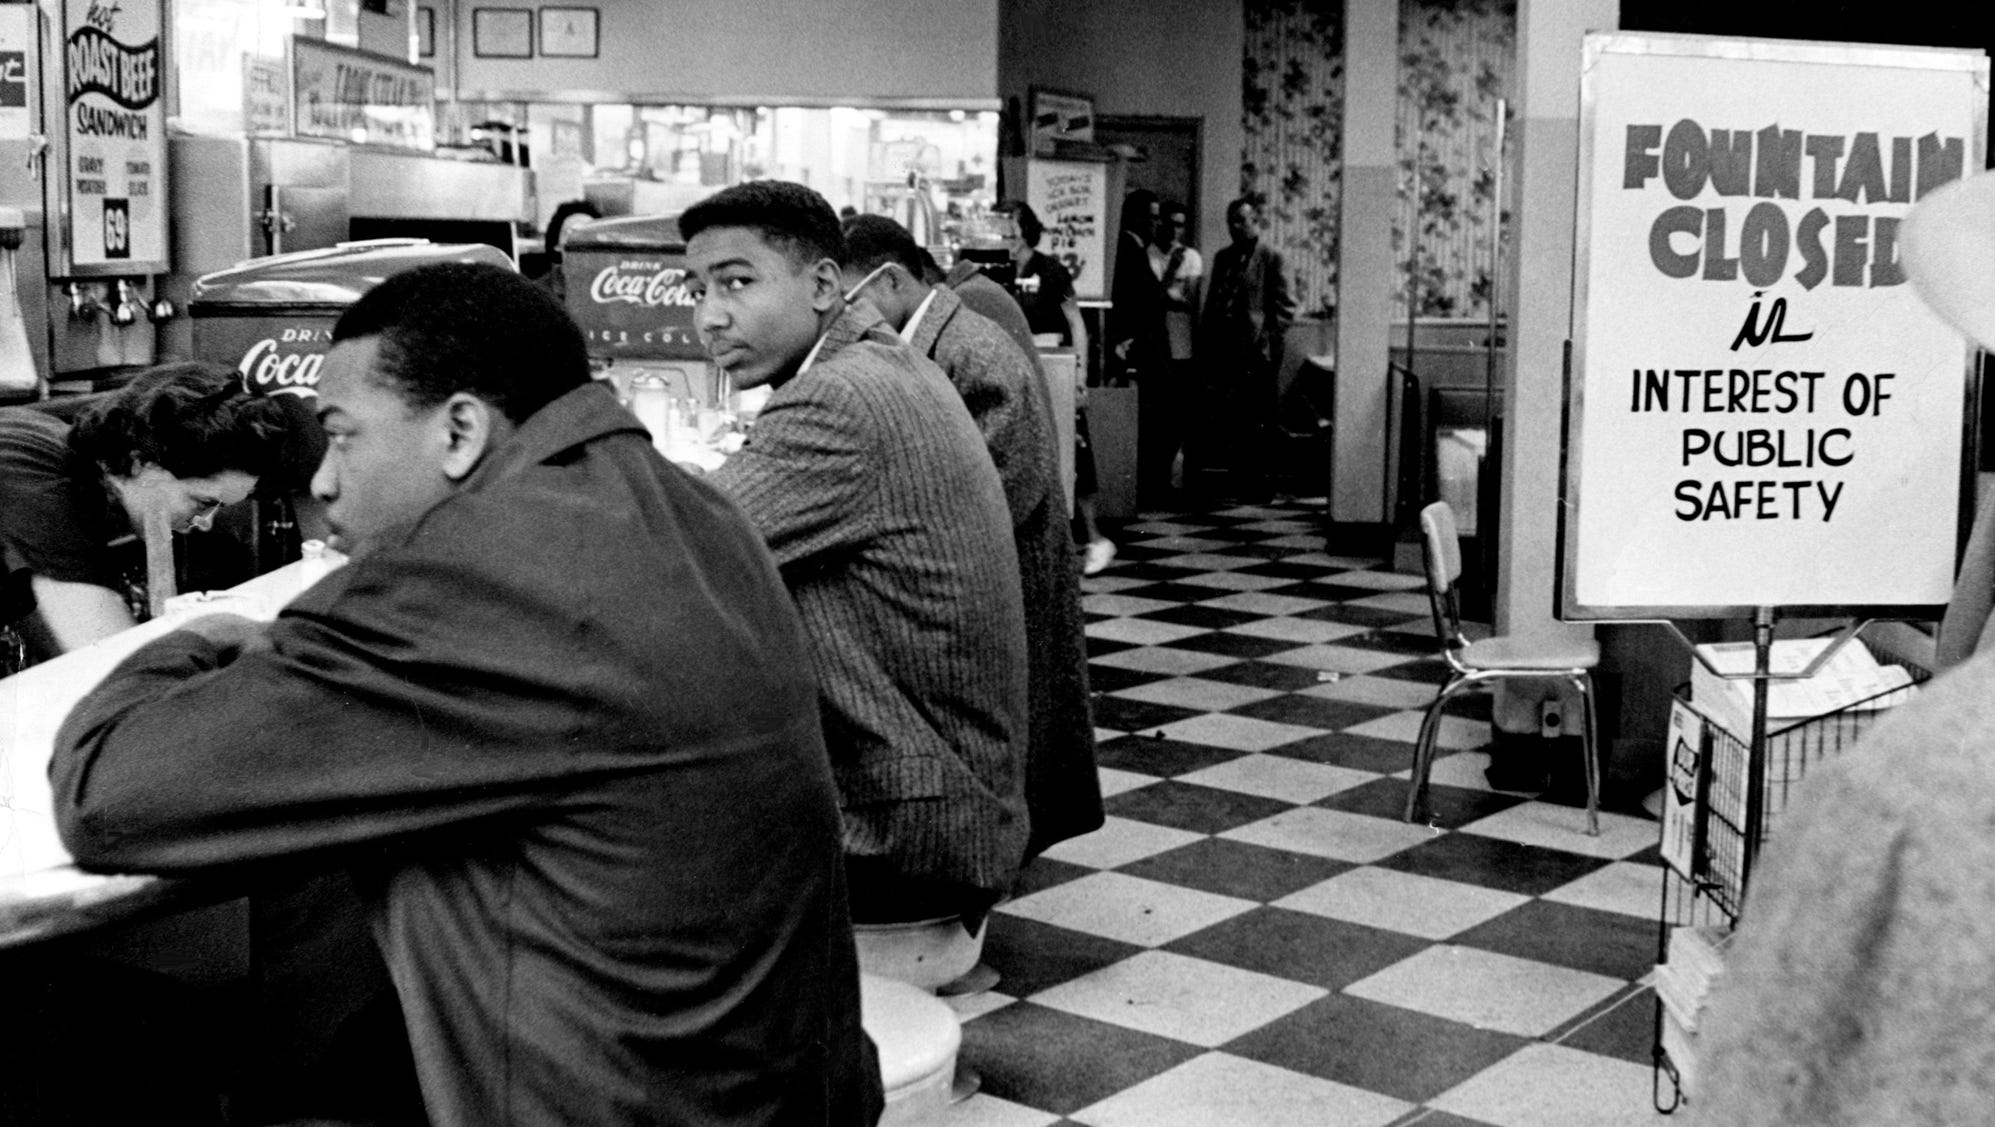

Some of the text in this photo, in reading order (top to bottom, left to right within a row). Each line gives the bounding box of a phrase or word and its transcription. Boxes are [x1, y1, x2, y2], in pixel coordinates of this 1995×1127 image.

[69, 33, 118, 95] ROAST
[120, 49, 155, 102] BEEF
[77, 102, 148, 140] SANDWICH
[1623, 118, 1965, 205] FOUNTAIN
[105, 207, 126, 250] 69
[590, 266, 696, 306] Coca-Cola
[620, 260, 662, 270] DRINK
[588, 330, 690, 344] ICE COL
[1730, 290, 1814, 351] in
[1630, 369, 1896, 416] INTEREST OF
[1682, 428, 1855, 468] PUBLIC
[1674, 479, 1844, 523] SAFETY
